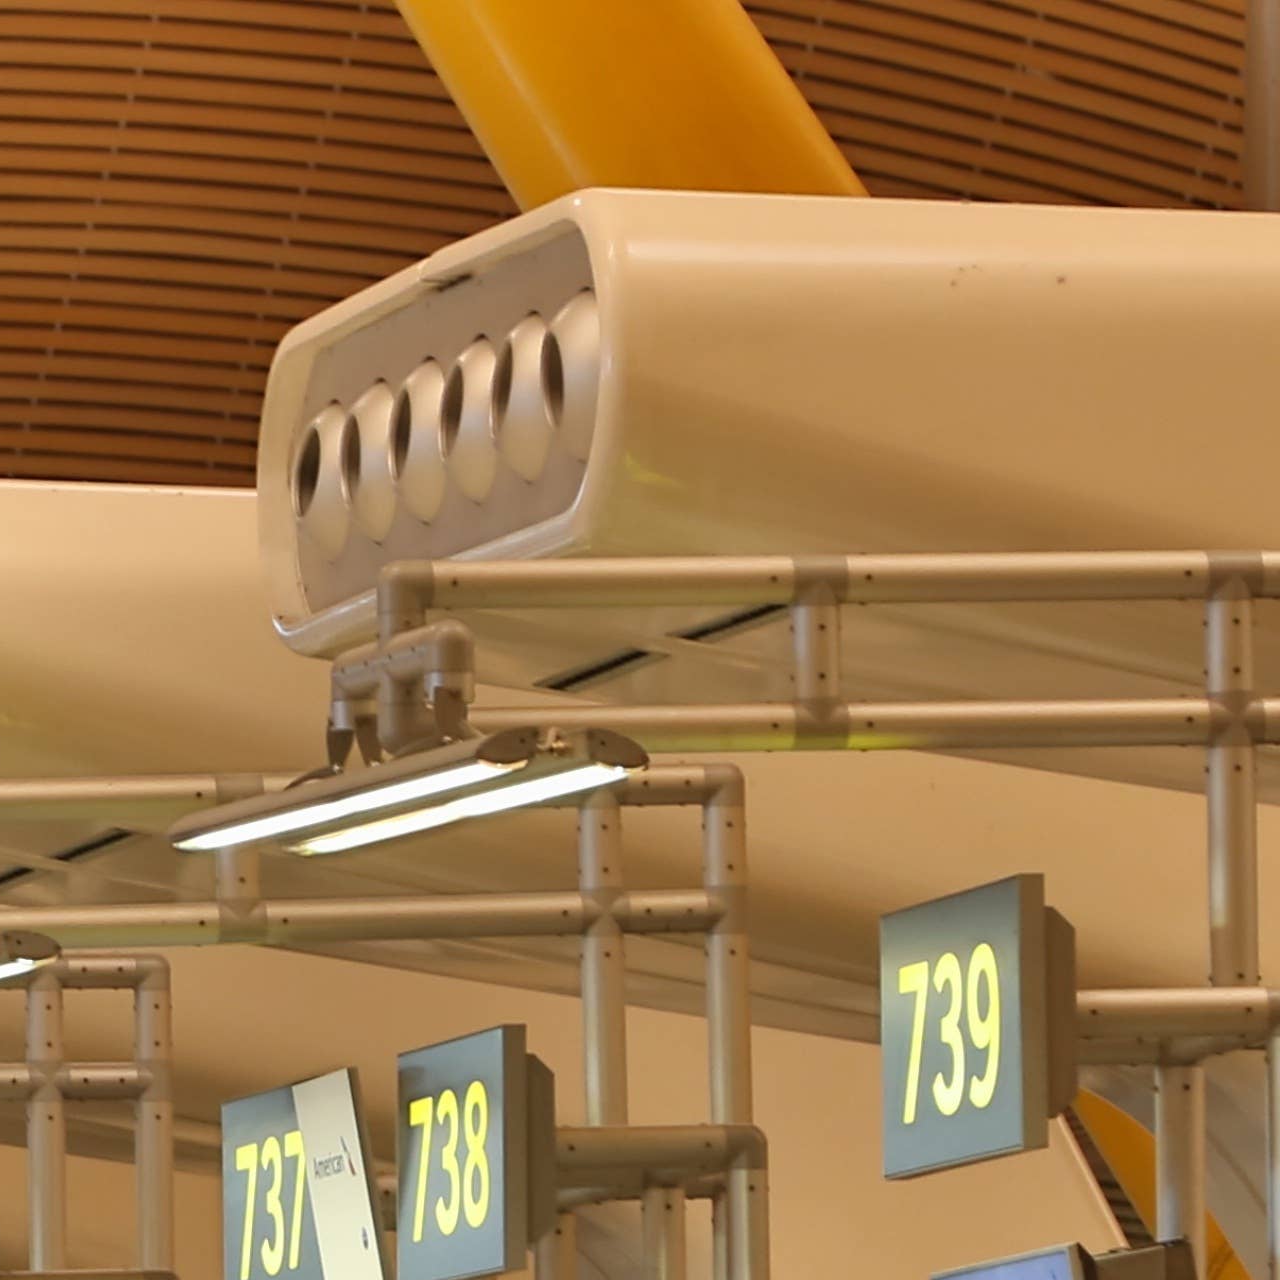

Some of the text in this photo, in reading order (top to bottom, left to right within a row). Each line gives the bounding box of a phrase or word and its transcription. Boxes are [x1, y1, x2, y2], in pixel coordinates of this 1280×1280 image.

[897, 942, 1002, 1124] 739
[313, 1152, 346, 1180] American
[409, 1081, 490, 1242] 738
